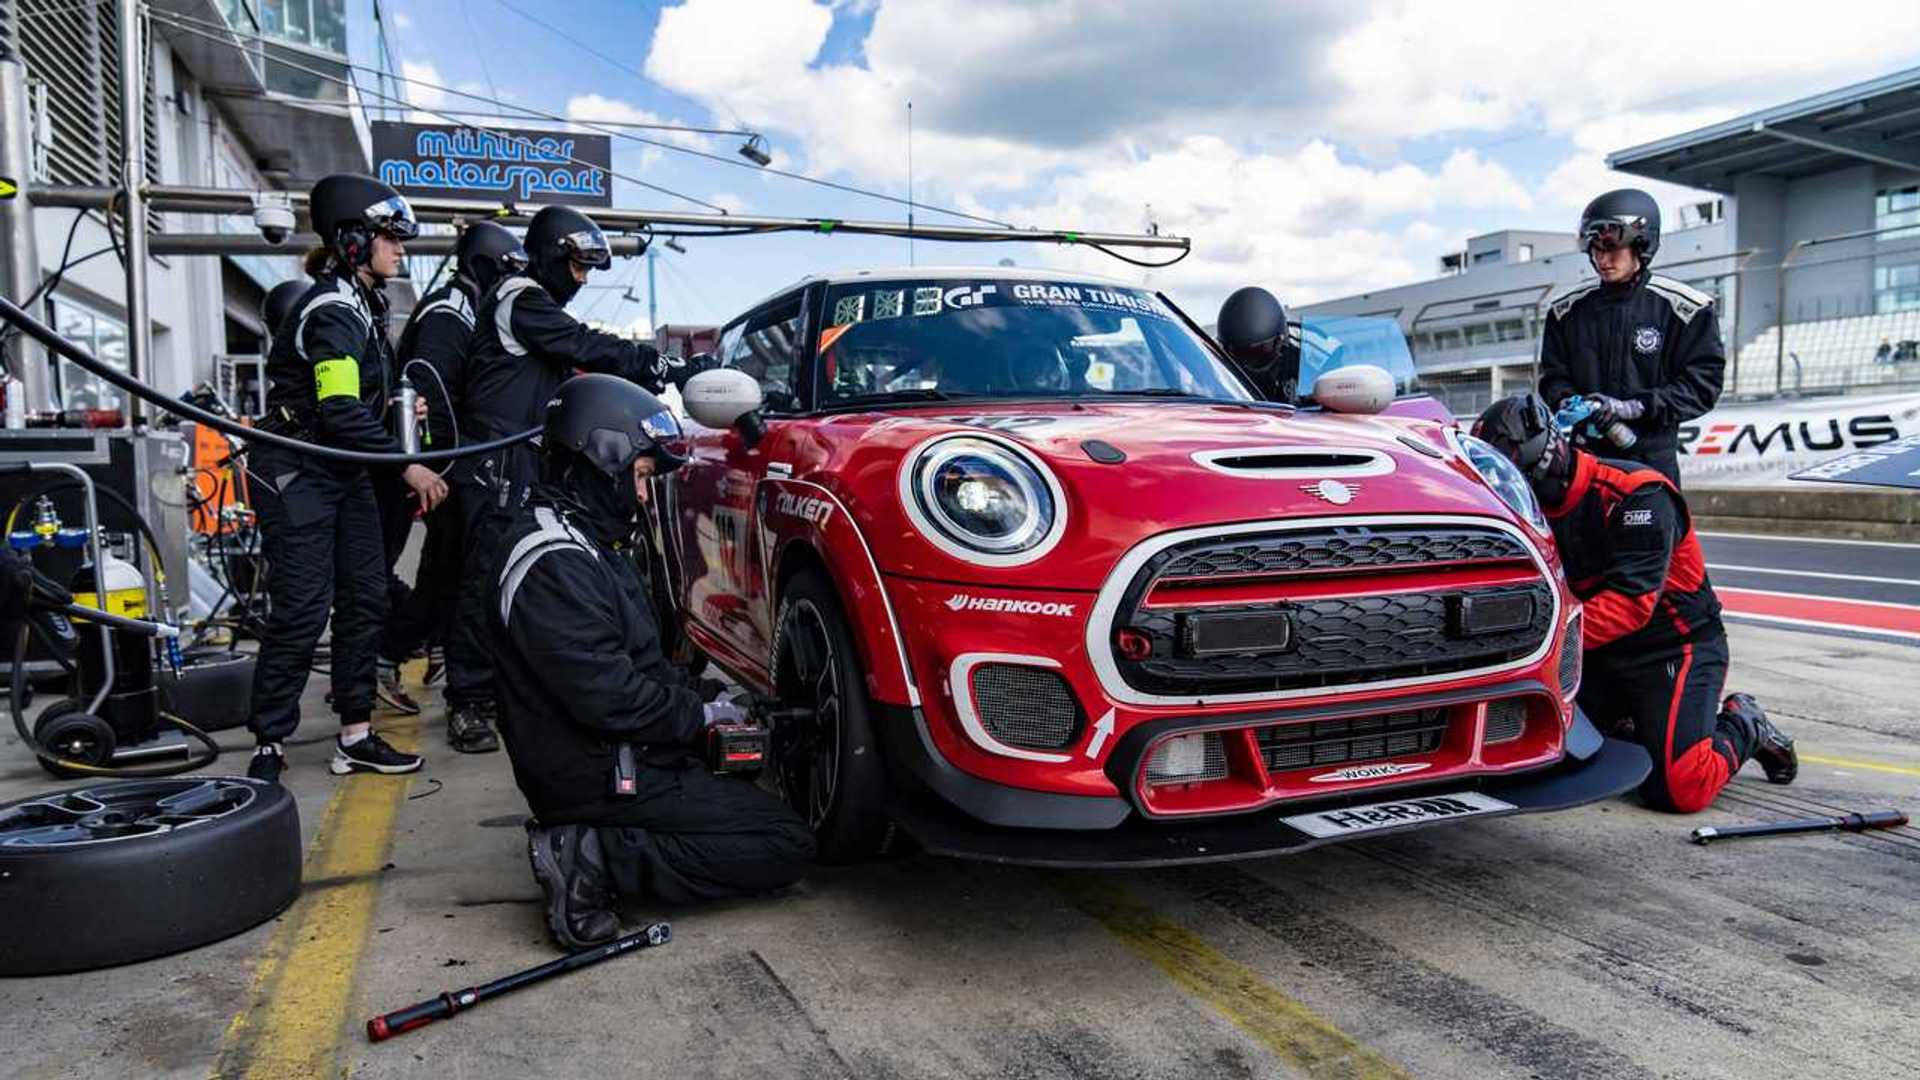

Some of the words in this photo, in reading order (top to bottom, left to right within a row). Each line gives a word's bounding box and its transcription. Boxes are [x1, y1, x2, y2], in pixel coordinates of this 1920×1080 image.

[379, 158, 605, 200] motorsport
[1012, 284, 1082, 300] GRAN
[1677, 414, 1900, 456] REMUS
[1623, 510, 1652, 525] OMP
[1342, 764, 1402, 779] WORKS
